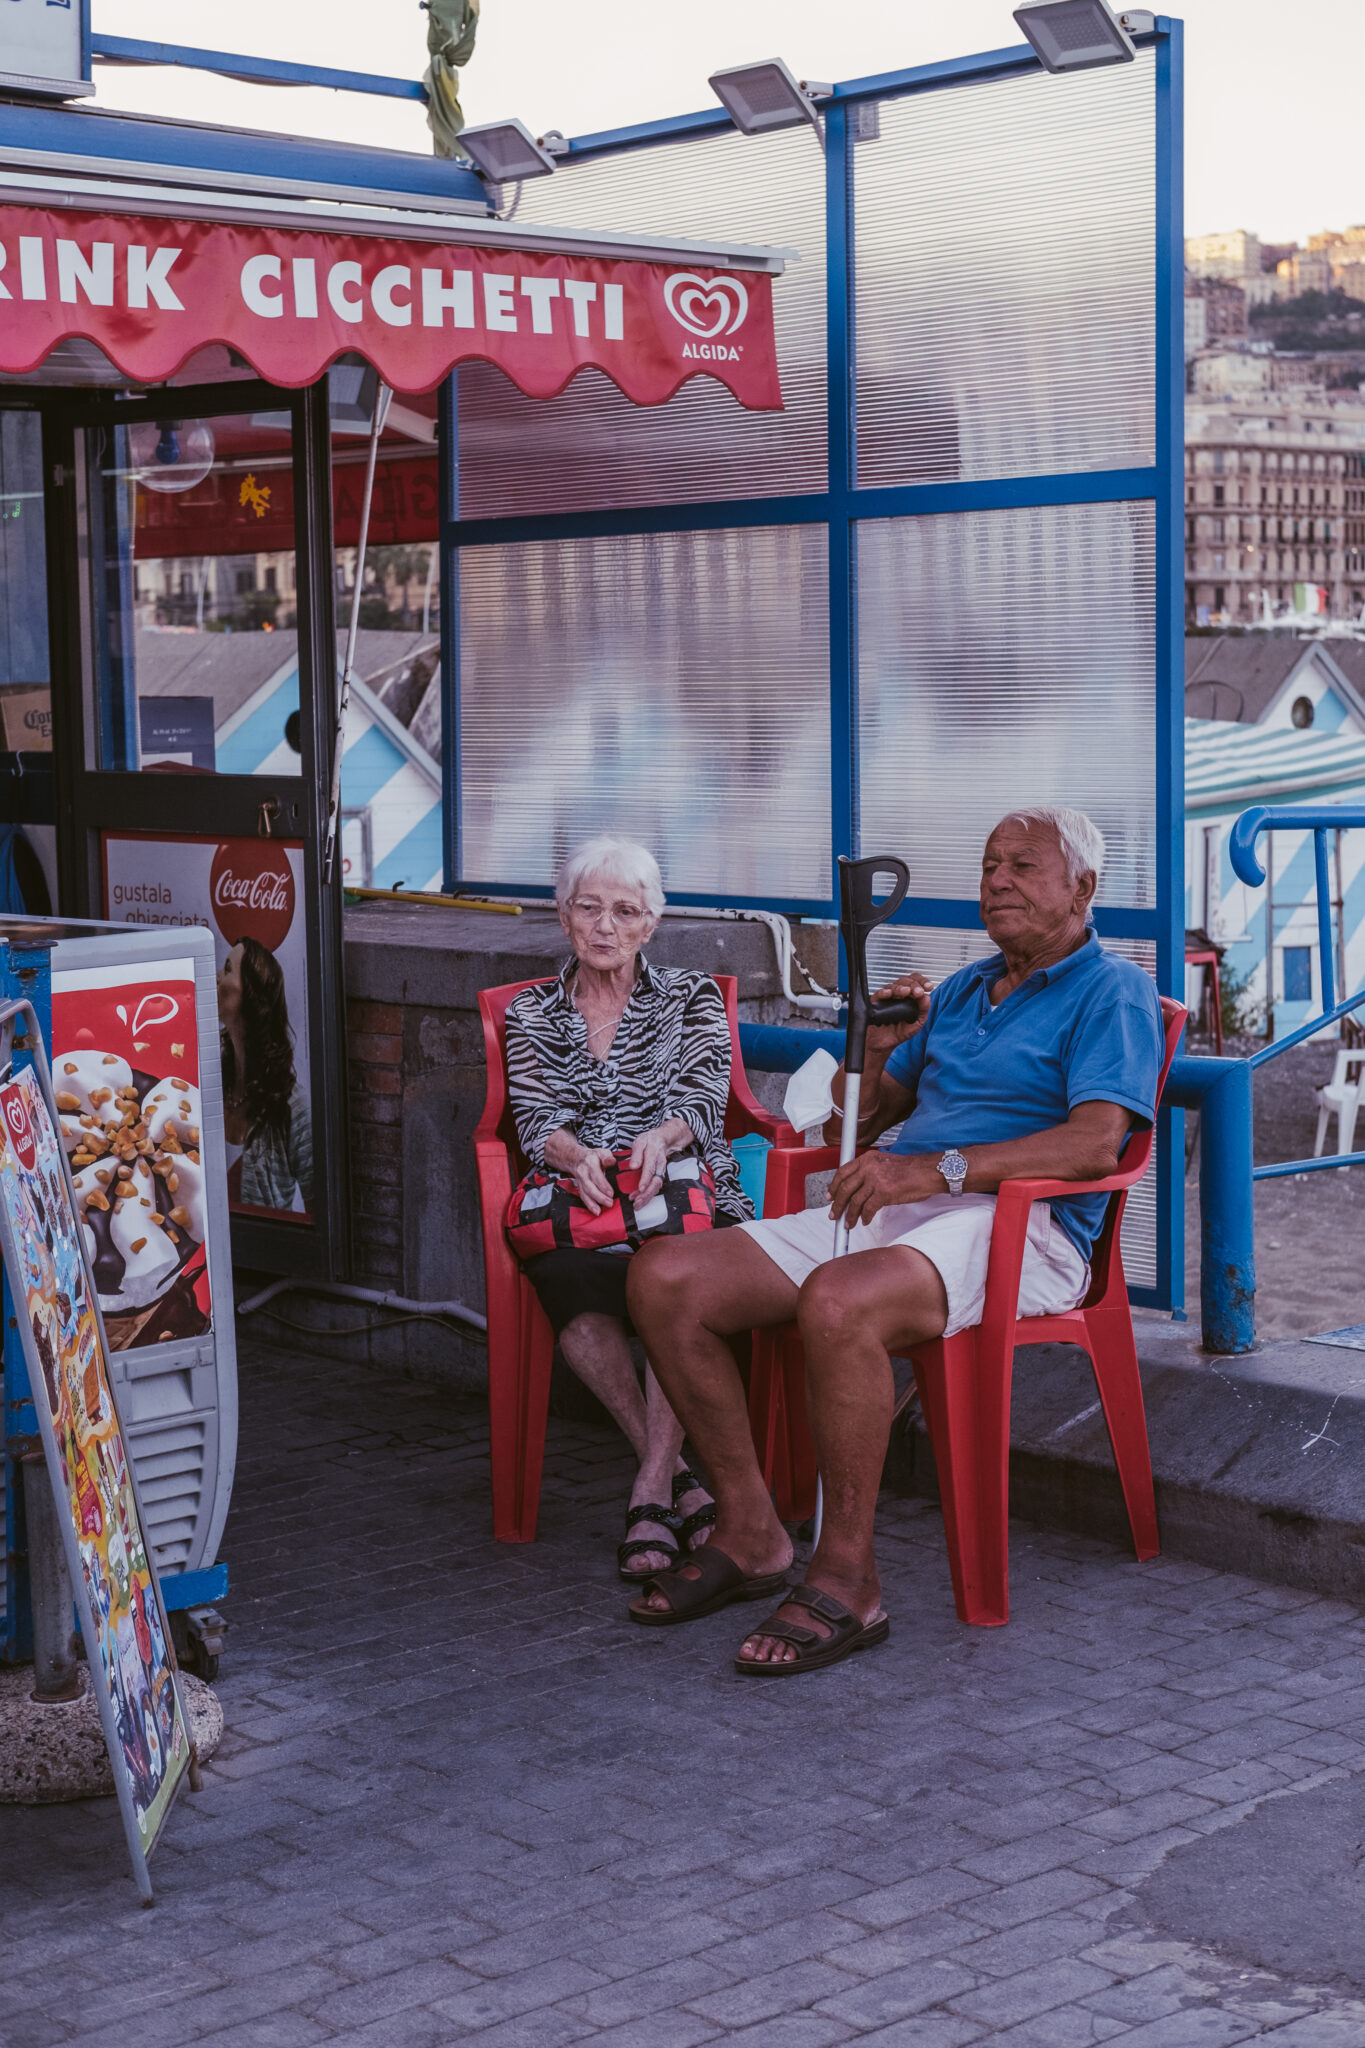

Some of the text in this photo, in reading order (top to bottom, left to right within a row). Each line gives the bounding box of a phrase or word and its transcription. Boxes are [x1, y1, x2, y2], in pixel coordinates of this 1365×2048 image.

[0, 235, 624, 341] INK CICCHETTI
[682, 342, 741, 361] ALGIDA
[113, 882, 172, 905] gustala
[215, 869, 290, 911] Coca-Cola
